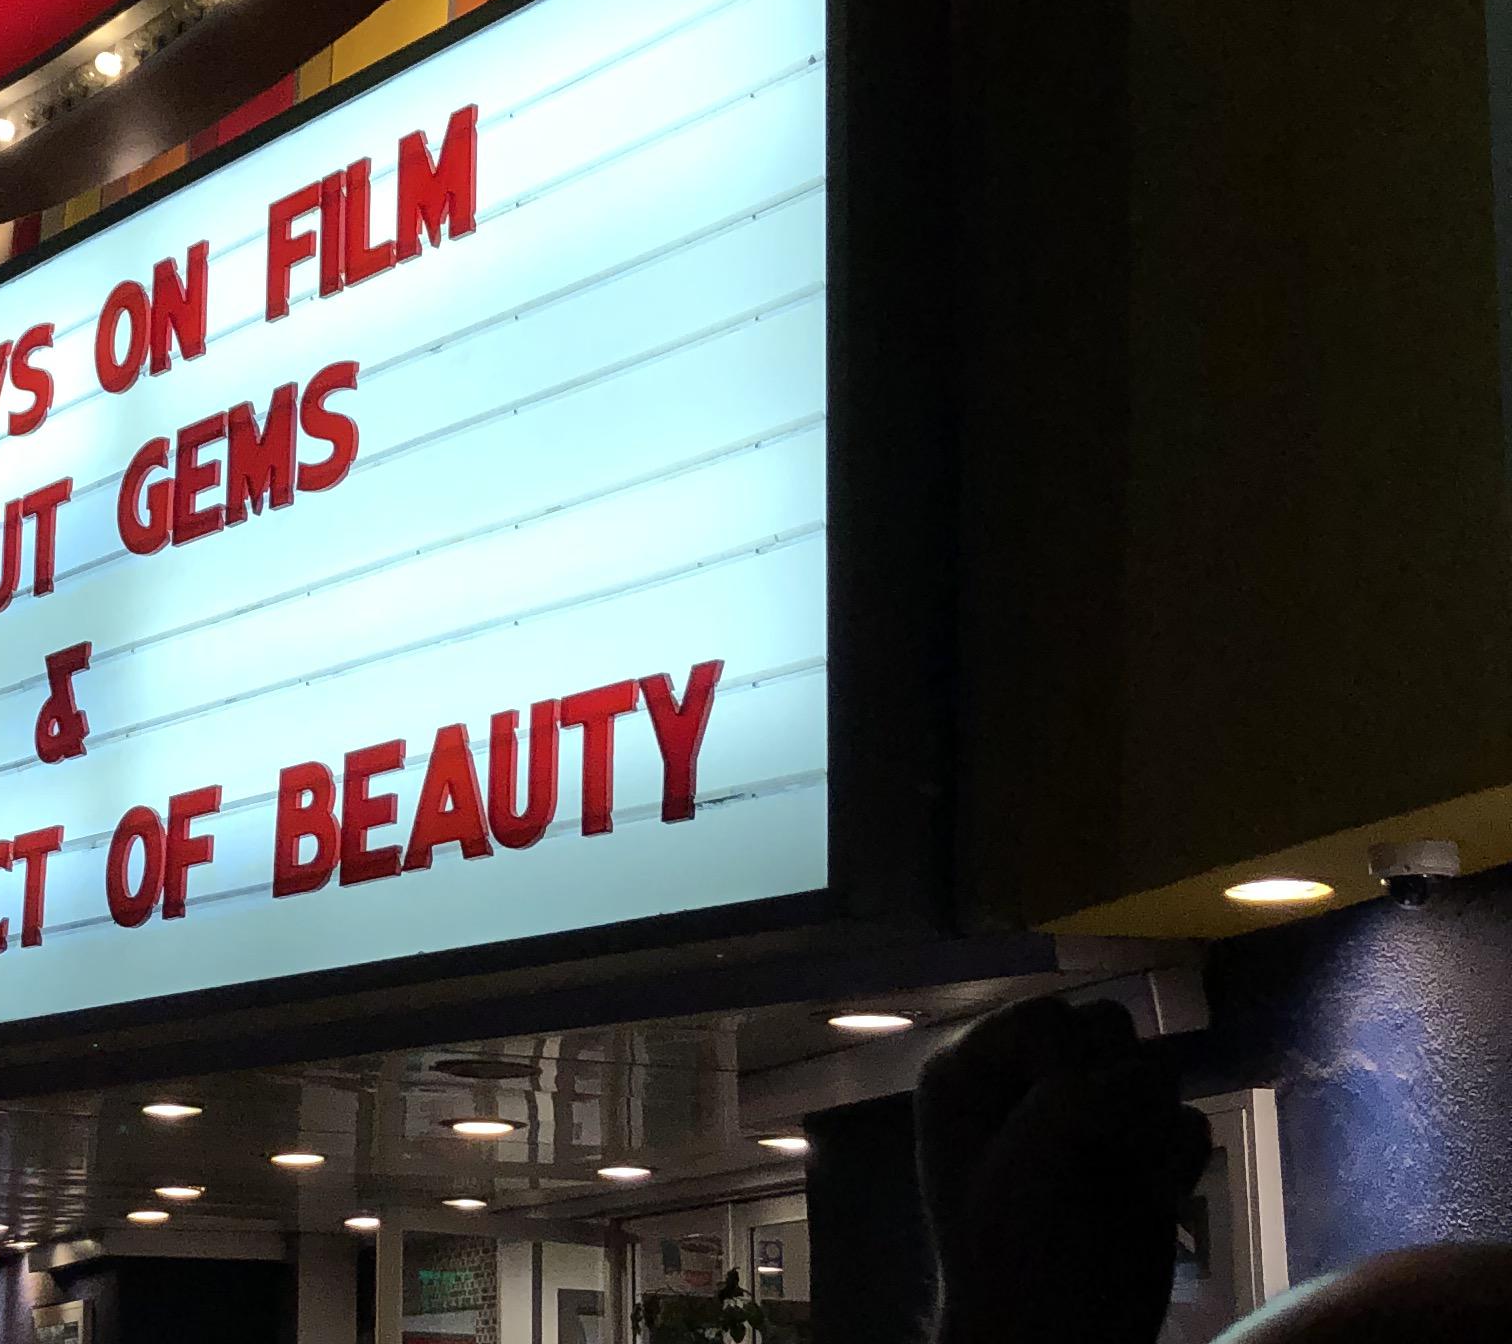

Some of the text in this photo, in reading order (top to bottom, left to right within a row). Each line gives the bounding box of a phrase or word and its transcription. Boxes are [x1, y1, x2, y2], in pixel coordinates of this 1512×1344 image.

[94, 242, 209, 394] ON
[266, 104, 479, 320] FILM
[117, 361, 360, 556] GEMS
[35, 643, 92, 762] &
[107, 786, 223, 928] OF
[273, 660, 724, 899] BEAUTY
